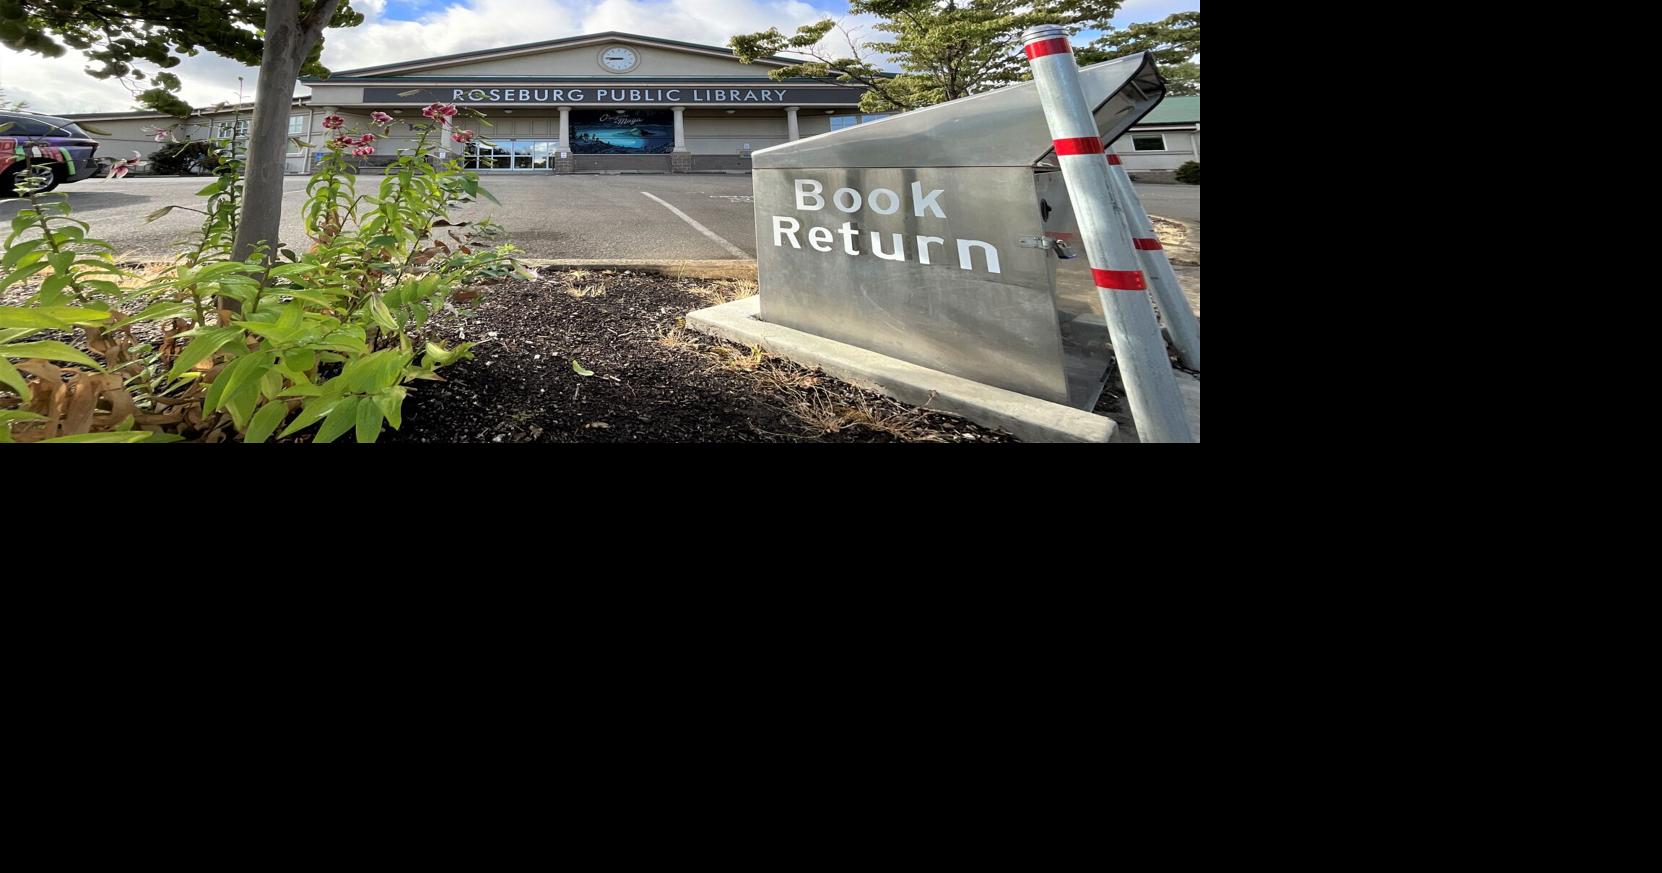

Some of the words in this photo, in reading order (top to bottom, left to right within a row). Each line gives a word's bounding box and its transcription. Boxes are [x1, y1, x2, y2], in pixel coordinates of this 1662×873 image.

[452, 89, 584, 101] ROSEBURG
[597, 89, 681, 101] PUBLIC
[693, 89, 787, 101] LIBRARY
[794, 178, 947, 218] Book
[772, 215, 1001, 274] Return
